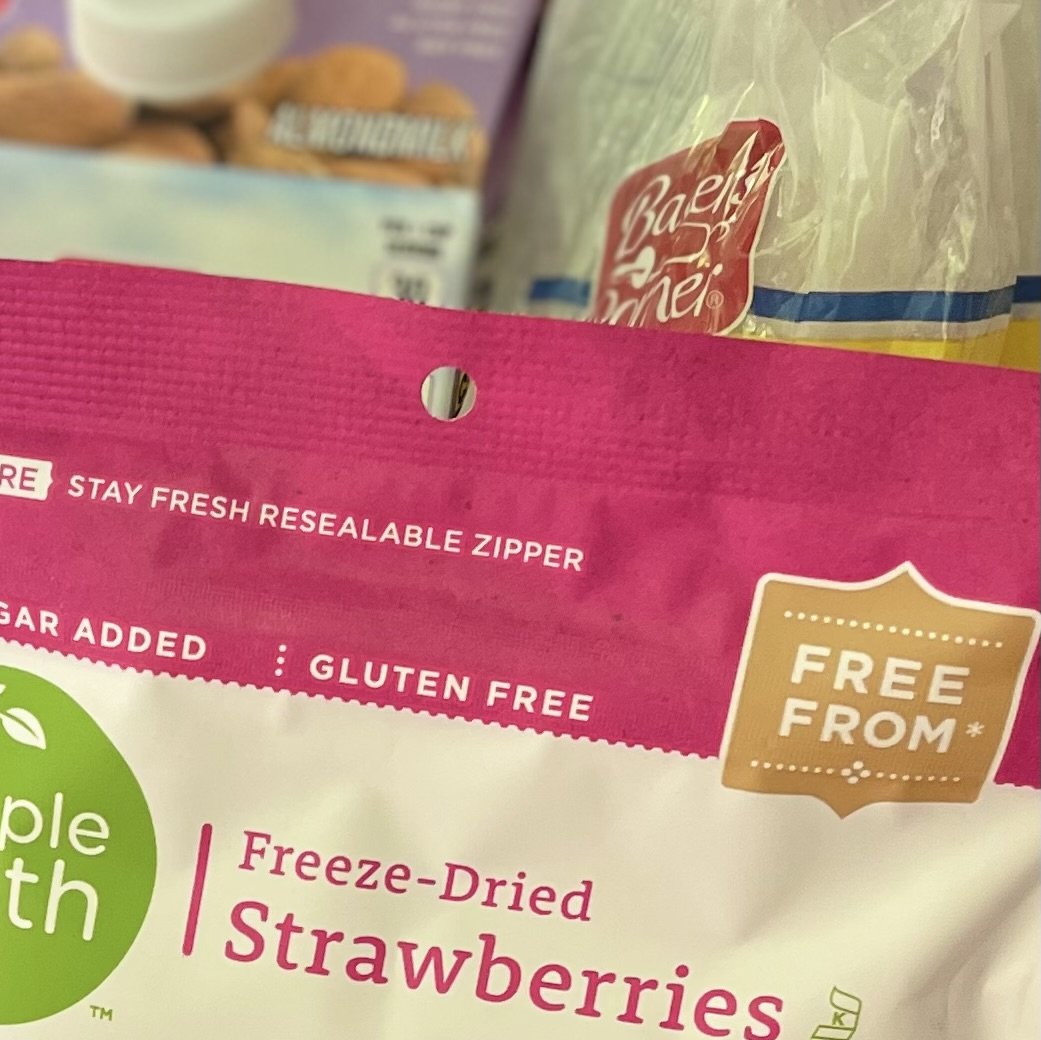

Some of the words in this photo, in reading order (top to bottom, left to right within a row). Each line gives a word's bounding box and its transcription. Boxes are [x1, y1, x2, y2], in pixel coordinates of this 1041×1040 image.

[67, 474, 142, 506] STAY
[150, 487, 250, 523] FRESH
[258, 504, 463, 553] RESEALABLE
[471, 533, 584, 572] ZIPPER
[73, 617, 208, 662] ADDED
[309, 654, 470, 701] GLUTEN
[486, 680, 594, 722] FREE
[790, 644, 971, 705] FREE
[238, 830, 595, 922] Freeze-Dried
[89, 1005, 113, 1021] TM
